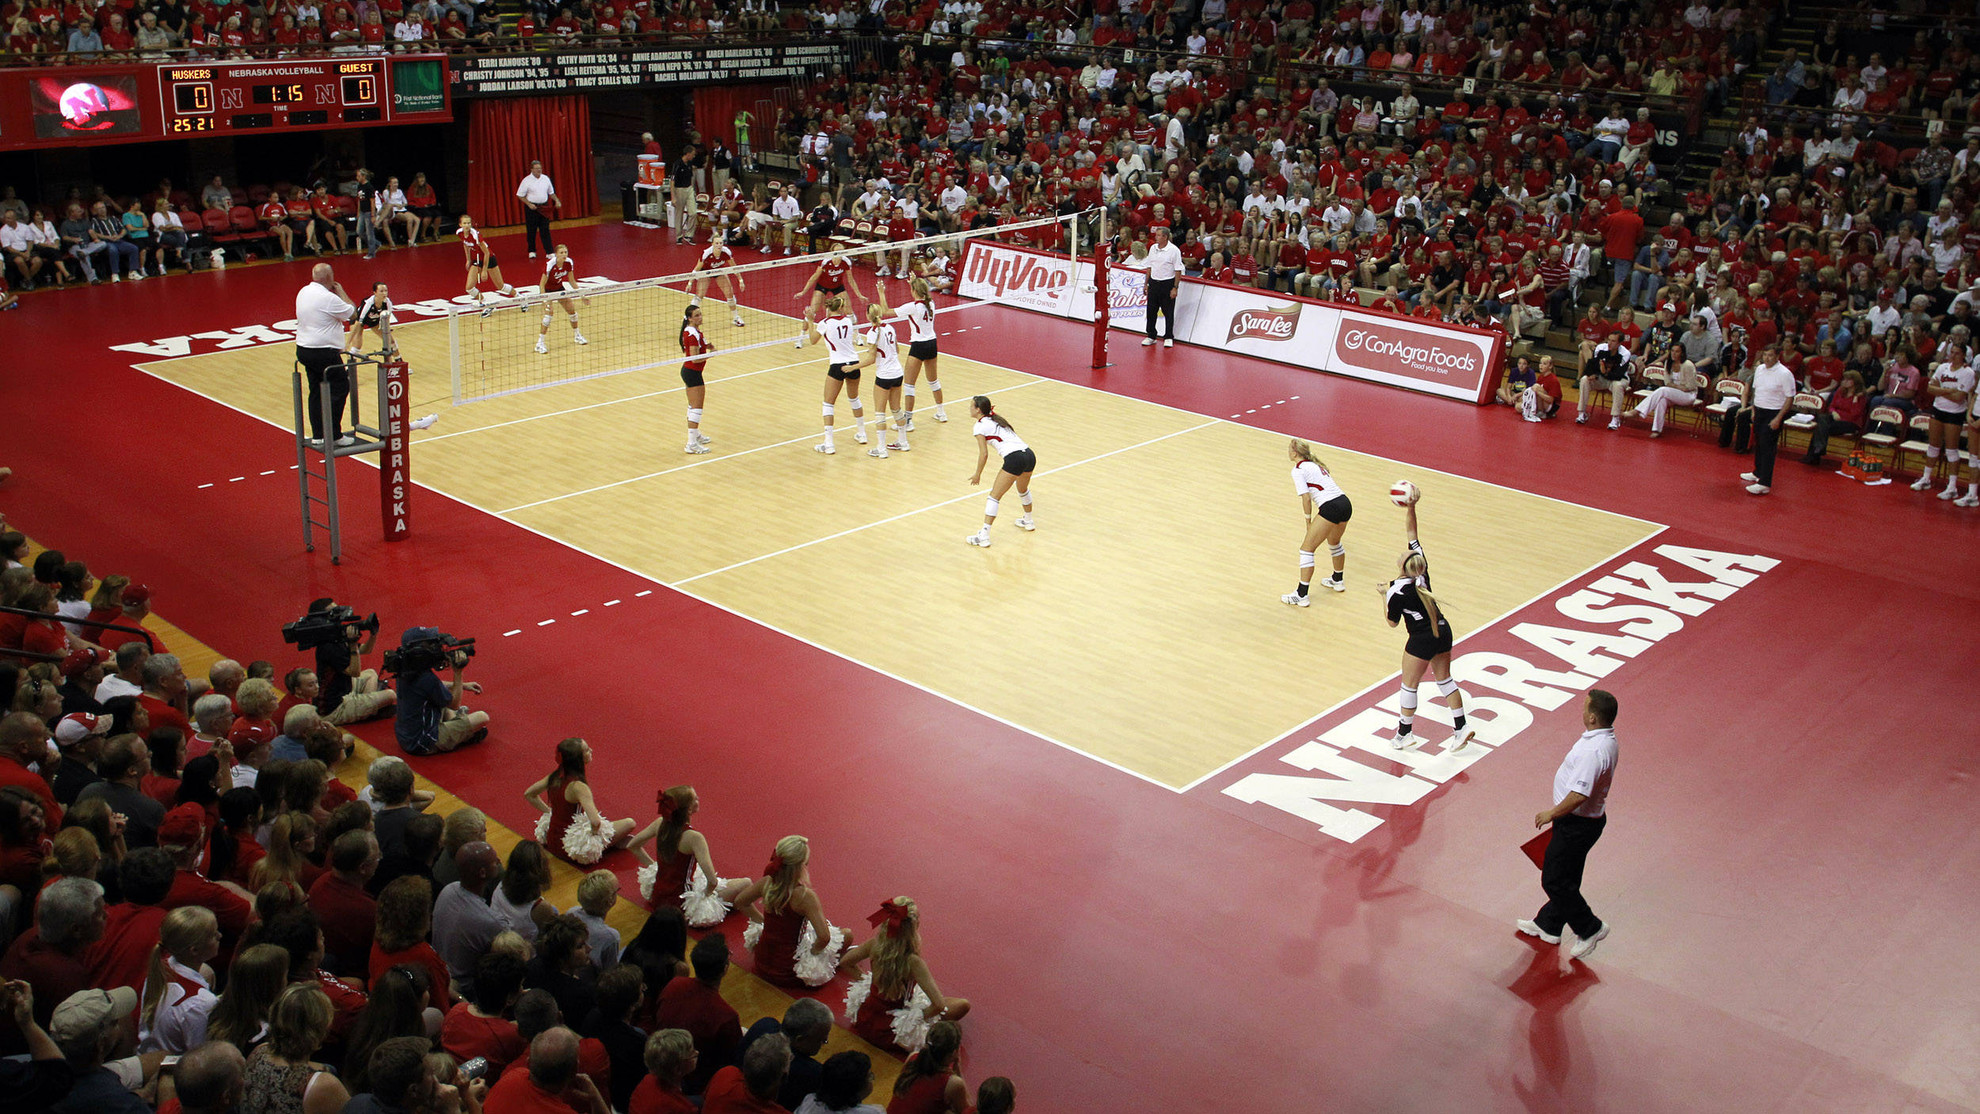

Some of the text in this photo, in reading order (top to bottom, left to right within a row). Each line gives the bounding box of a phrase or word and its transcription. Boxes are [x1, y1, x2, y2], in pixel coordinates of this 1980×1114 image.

[478, 58, 498, 68] TERRI
[557, 55, 578, 65] CATHY
[172, 69, 211, 80] HUSKERS
[229, 66, 324, 78] NEBRASKA VOLLEYBALL
[340, 63, 373, 73] GUEST
[463, 70, 493, 80] CHRISTY
[494, 69, 524, 79] JOHNSON
[564, 66, 578, 76] LISA
[479, 81, 506, 92] JORDAN
[507, 80, 534, 91] LARSON
[575, 77, 597, 86] TRACY
[597, 76, 621, 86] STALLS
[272, 85, 303, 101] 1:15
[315, 84, 336, 104] N
[359, 80, 370, 99] 0
[194, 87, 207, 108] 0
[221, 88, 243, 109] N
[1036, 299, 1057, 308] OWNED
[1109, 287, 1147, 308] Robe
[837, 325, 848, 339] 17
[1233, 313, 1292, 337] Sara Lee
[885, 331, 894, 345] 12
[1365, 335, 1475, 371] ConAgra Foods
[1411, 361, 1425, 369] Food
[1437, 366, 1449, 375] love
[389, 404, 407, 533] NEBRASKA
[1220, 543, 1782, 844] NEBRASKA
